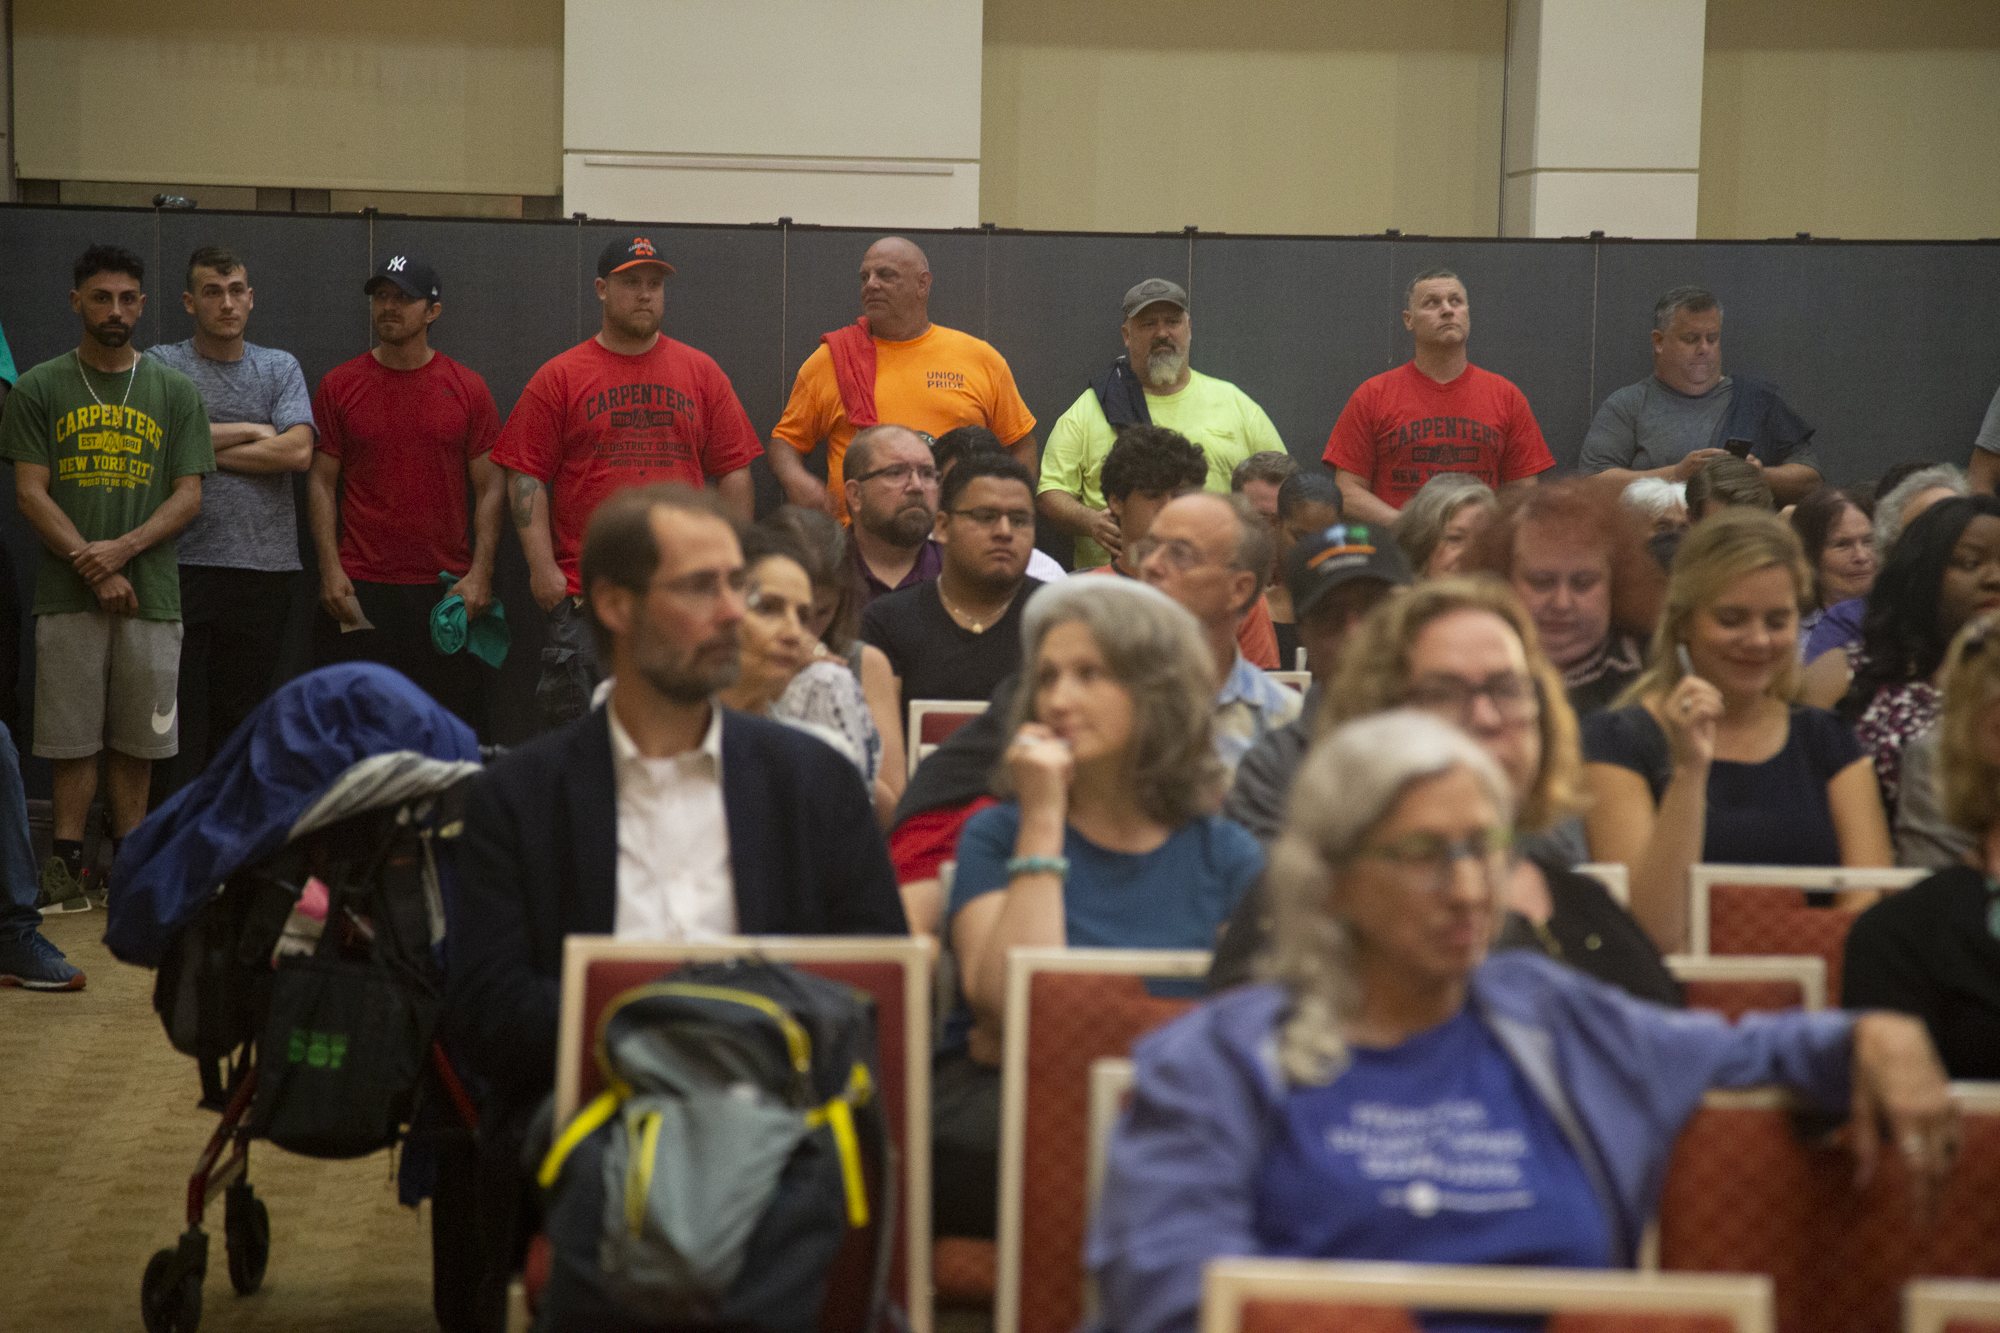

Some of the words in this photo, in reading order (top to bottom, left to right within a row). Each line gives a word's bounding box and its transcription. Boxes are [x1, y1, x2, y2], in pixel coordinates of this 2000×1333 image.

[926, 371, 964, 382] UNION
[927, 380, 964, 389] PRIDE
[586, 383, 695, 422] CARPENTERS
[56, 404, 163, 451] CARPENTERS
[1388, 416, 1499, 454] CARPENTERS
[609, 441, 653, 452] DISTRICT
[656, 441, 693, 456] COUNCIL
[59, 456, 88, 474] NEW
[92, 455, 127, 472] YORK
[1391, 469, 1421, 484] NEW
